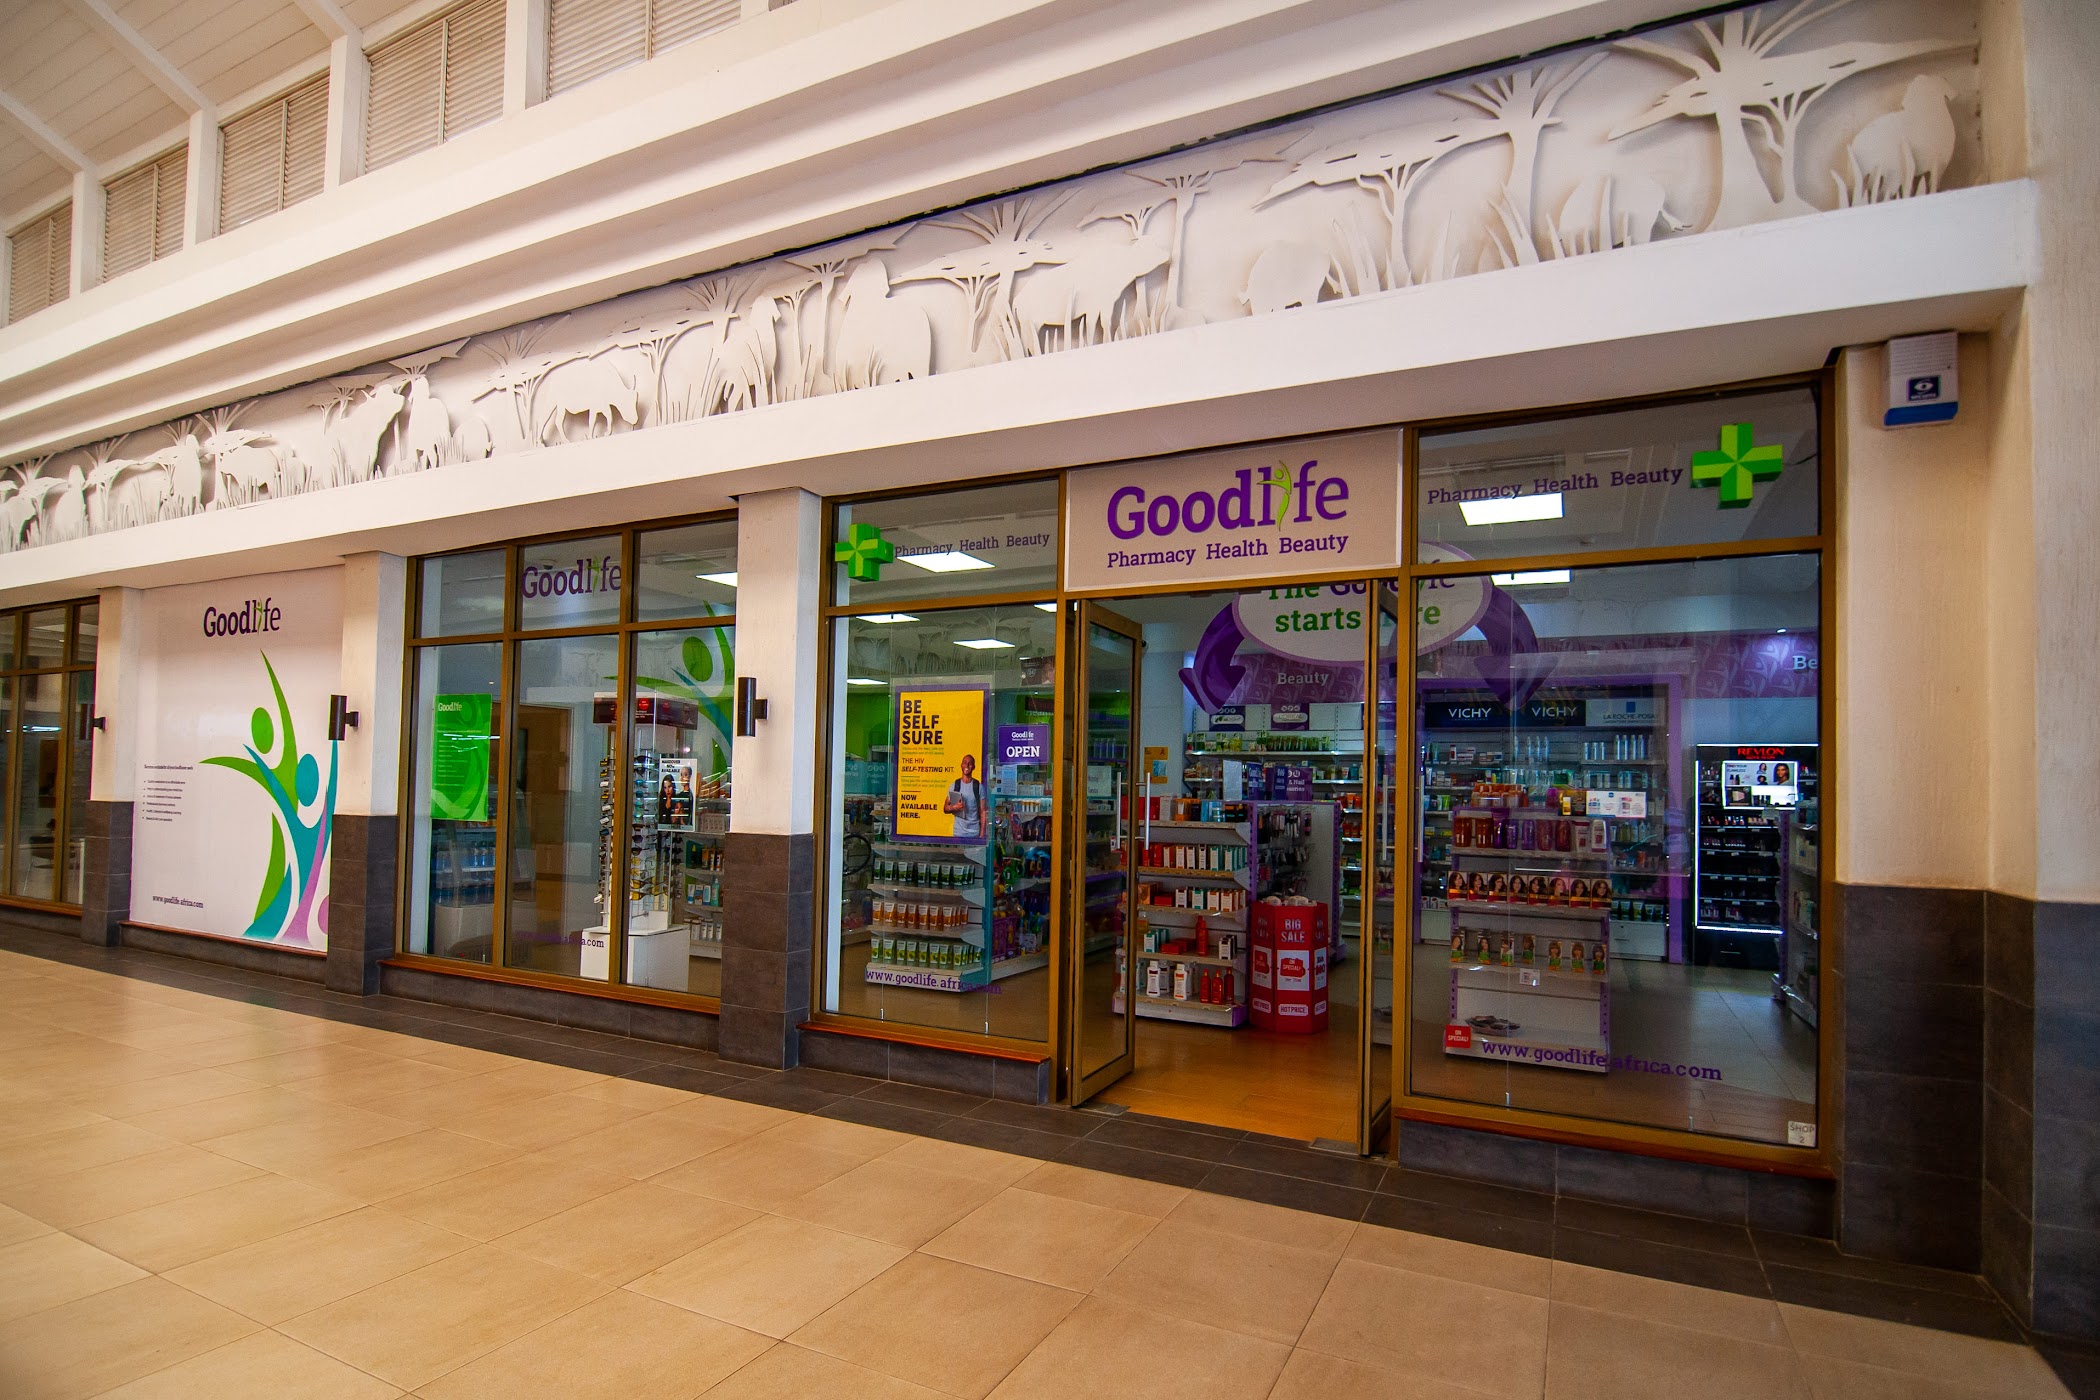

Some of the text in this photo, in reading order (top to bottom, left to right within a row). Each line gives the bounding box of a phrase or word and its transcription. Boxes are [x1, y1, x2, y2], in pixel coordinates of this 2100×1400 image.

[1427, 467, 1684, 504] Pharmacy Health Beauty
[1107, 459, 1349, 540] Goodlife
[895, 532, 1050, 557] Pharmacy Health Beauty
[1107, 534, 1349, 568] Pharmacy Health Beauty
[521, 555, 622, 599] Goodlife
[203, 597, 281, 638] Goodlife
[1275, 607, 1362, 633] starts
[1277, 672, 1329, 687] Beauty
[903, 700, 922, 714] BE
[1448, 707, 1492, 718] VICHY
[1531, 706, 1578, 717] VICHY
[902, 715, 940, 729] SELF
[902, 730, 943, 745] SURE
[1006, 745, 1040, 758] OPEN
[1737, 747, 1786, 756] REVLON
[901, 803, 938, 811] AVAILABLE
[1285, 918, 1301, 931] BIG
[1281, 931, 1306, 943] SALE
[1482, 1042, 1722, 1080] www.goodlifeafrica.com
[1790, 1122, 1815, 1133] SHOP
[1799, 1136, 1805, 1144] 2
